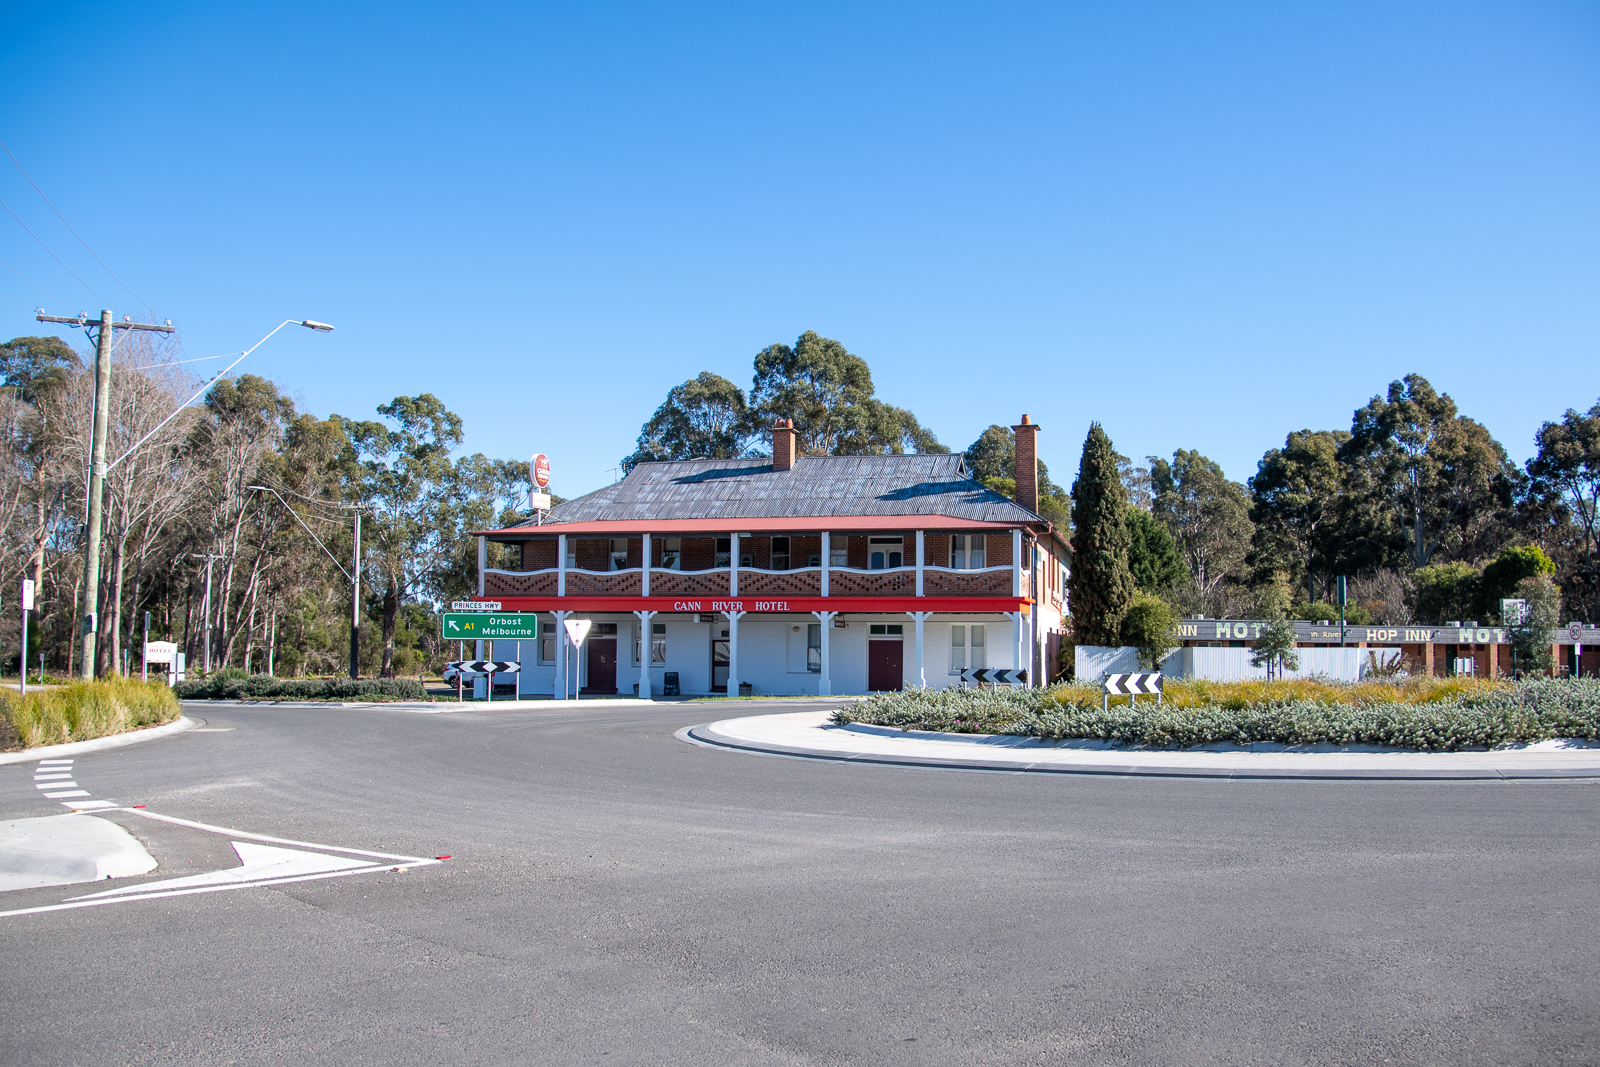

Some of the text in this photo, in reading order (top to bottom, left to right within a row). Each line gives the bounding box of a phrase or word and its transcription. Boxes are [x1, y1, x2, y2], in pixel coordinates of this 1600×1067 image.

[674, 601, 790, 611] CANN RIVER HOTEL
[489, 617, 522, 625] Orbost
[464, 622, 475, 630] A1
[1173, 622, 1298, 639] NN MOT
[482, 627, 532, 636] Melbourne
[1366, 629, 1398, 641] HOP
[1405, 629, 1431, 641] INN
[1459, 628, 1506, 643] MOT
